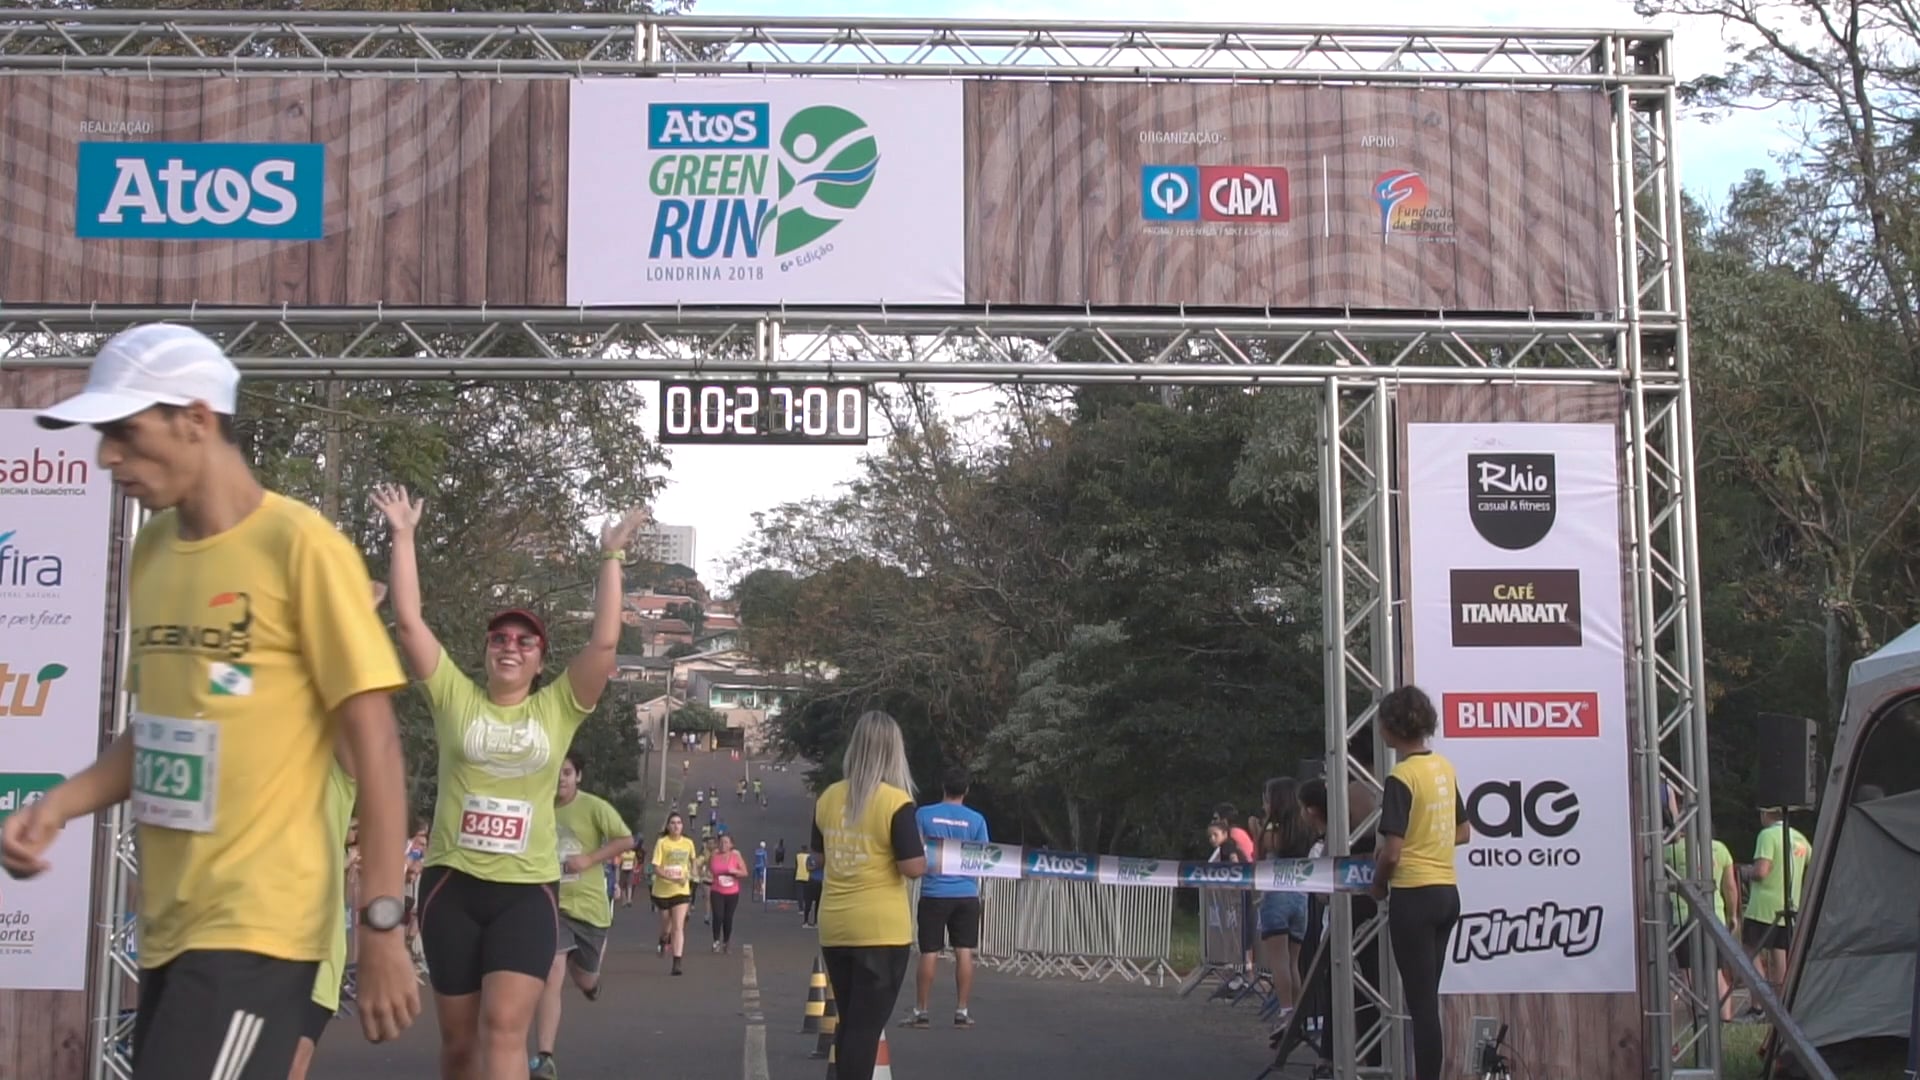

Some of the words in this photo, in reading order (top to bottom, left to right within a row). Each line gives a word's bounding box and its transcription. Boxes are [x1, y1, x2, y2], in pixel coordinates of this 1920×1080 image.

[649, 155, 768, 196] GREEN
[1209, 172, 1278, 216] CAPA
[648, 199, 768, 259] RUN
[796, 243, 834, 267] Edição
[647, 267, 721, 281] LONDRINA
[729, 266, 764, 281] 2018
[666, 386, 862, 435] 00:27:00
[1477, 461, 1548, 493] Rhio
[1478, 500, 1508, 512] casual
[1510, 501, 1517, 511] &
[1519, 500, 1551, 512] fitness
[1493, 583, 1535, 600] CAFÉ
[1462, 603, 1568, 623] ITAMARATY
[465, 814, 518, 838] 3495
[1468, 849, 1521, 866] alto
[1453, 902, 1603, 963] Rinthy
